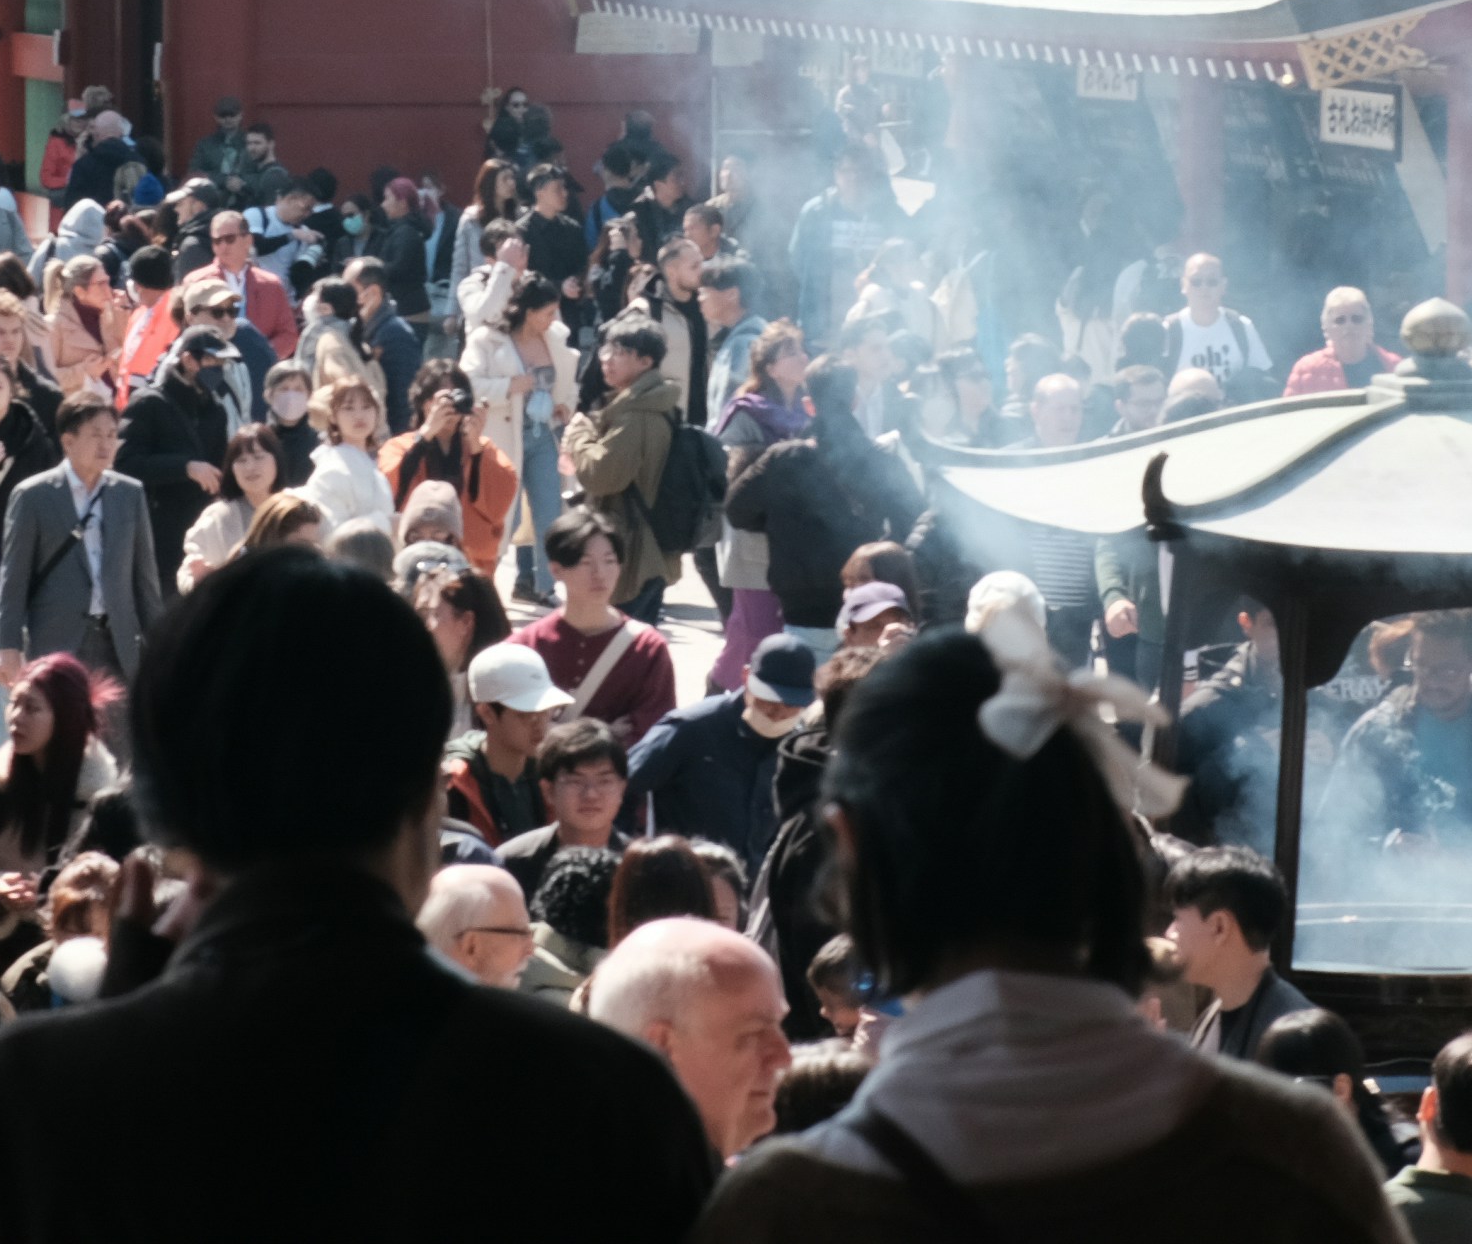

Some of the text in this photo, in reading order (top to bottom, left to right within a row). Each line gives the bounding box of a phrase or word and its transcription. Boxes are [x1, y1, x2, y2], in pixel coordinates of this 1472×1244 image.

[1327, 94, 1396, 138] 古札お納め所
